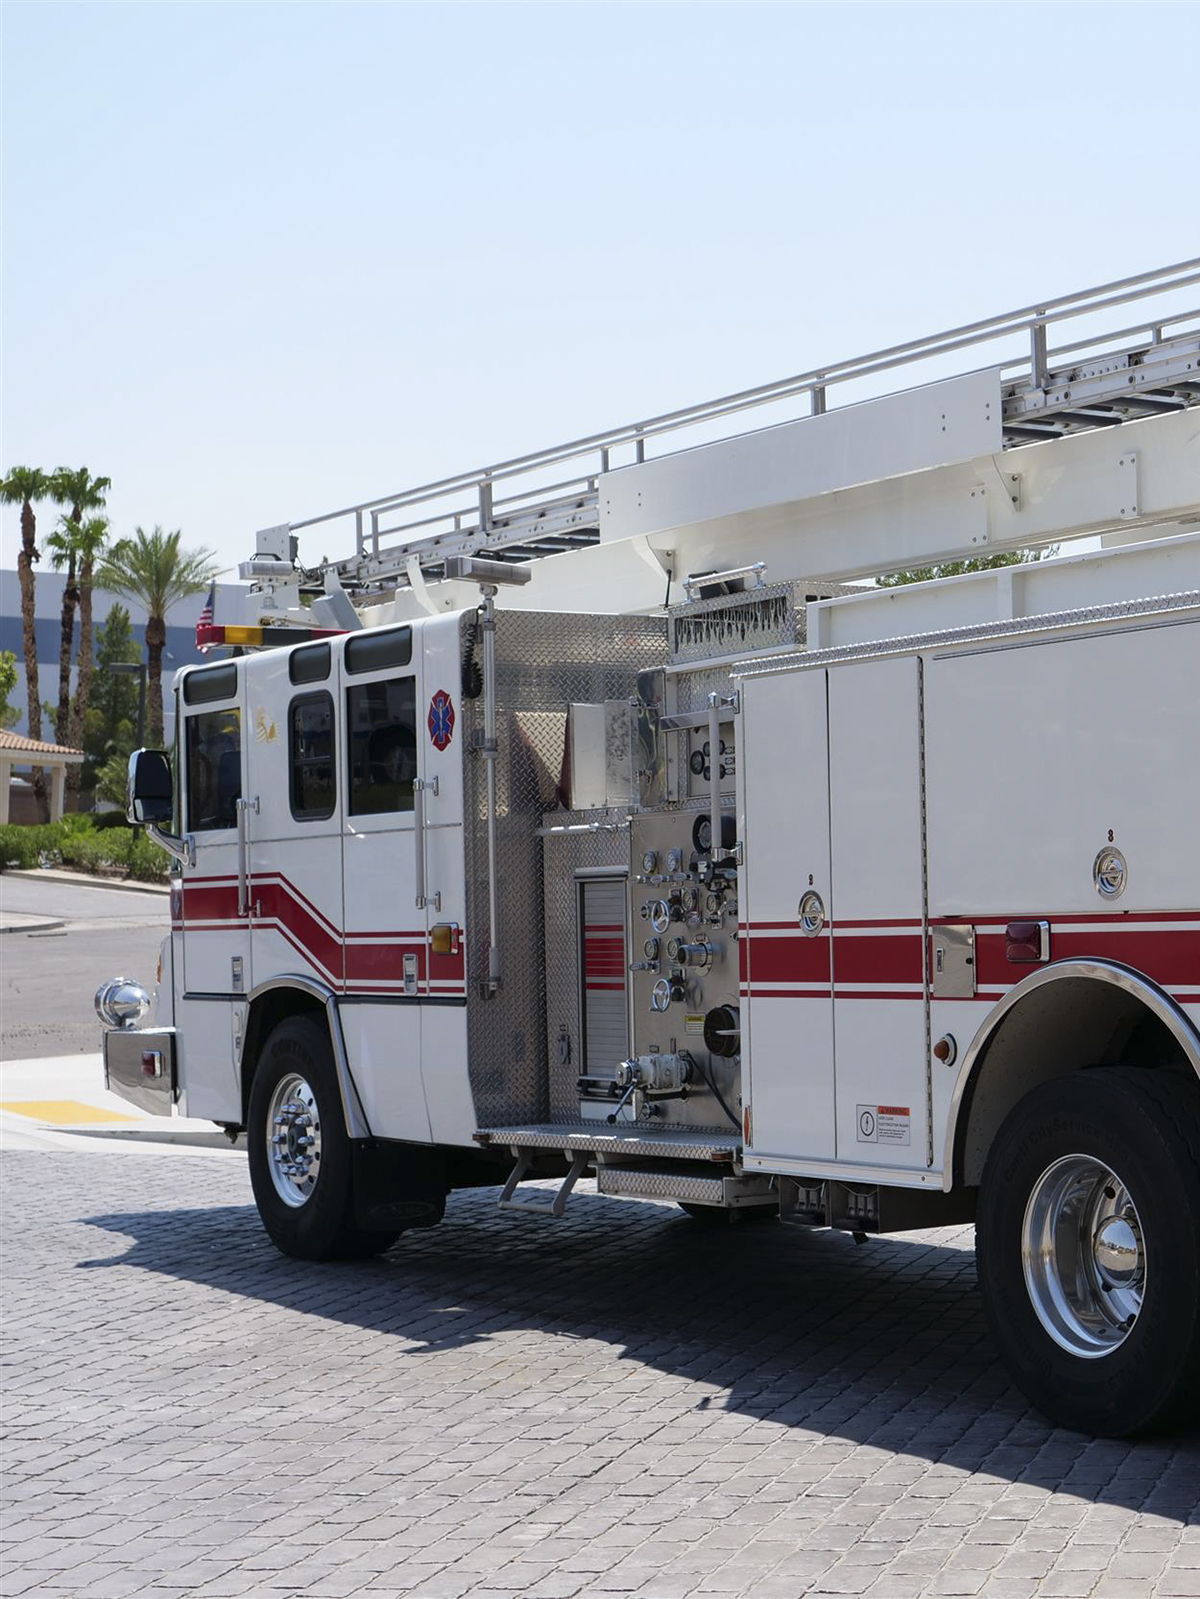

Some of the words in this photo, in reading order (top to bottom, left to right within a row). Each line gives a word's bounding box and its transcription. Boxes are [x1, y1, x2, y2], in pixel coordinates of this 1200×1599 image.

[1108, 829, 1114, 842] 8
[808, 873, 814, 886] 9
[1028, 1117, 1100, 1146] CityService
